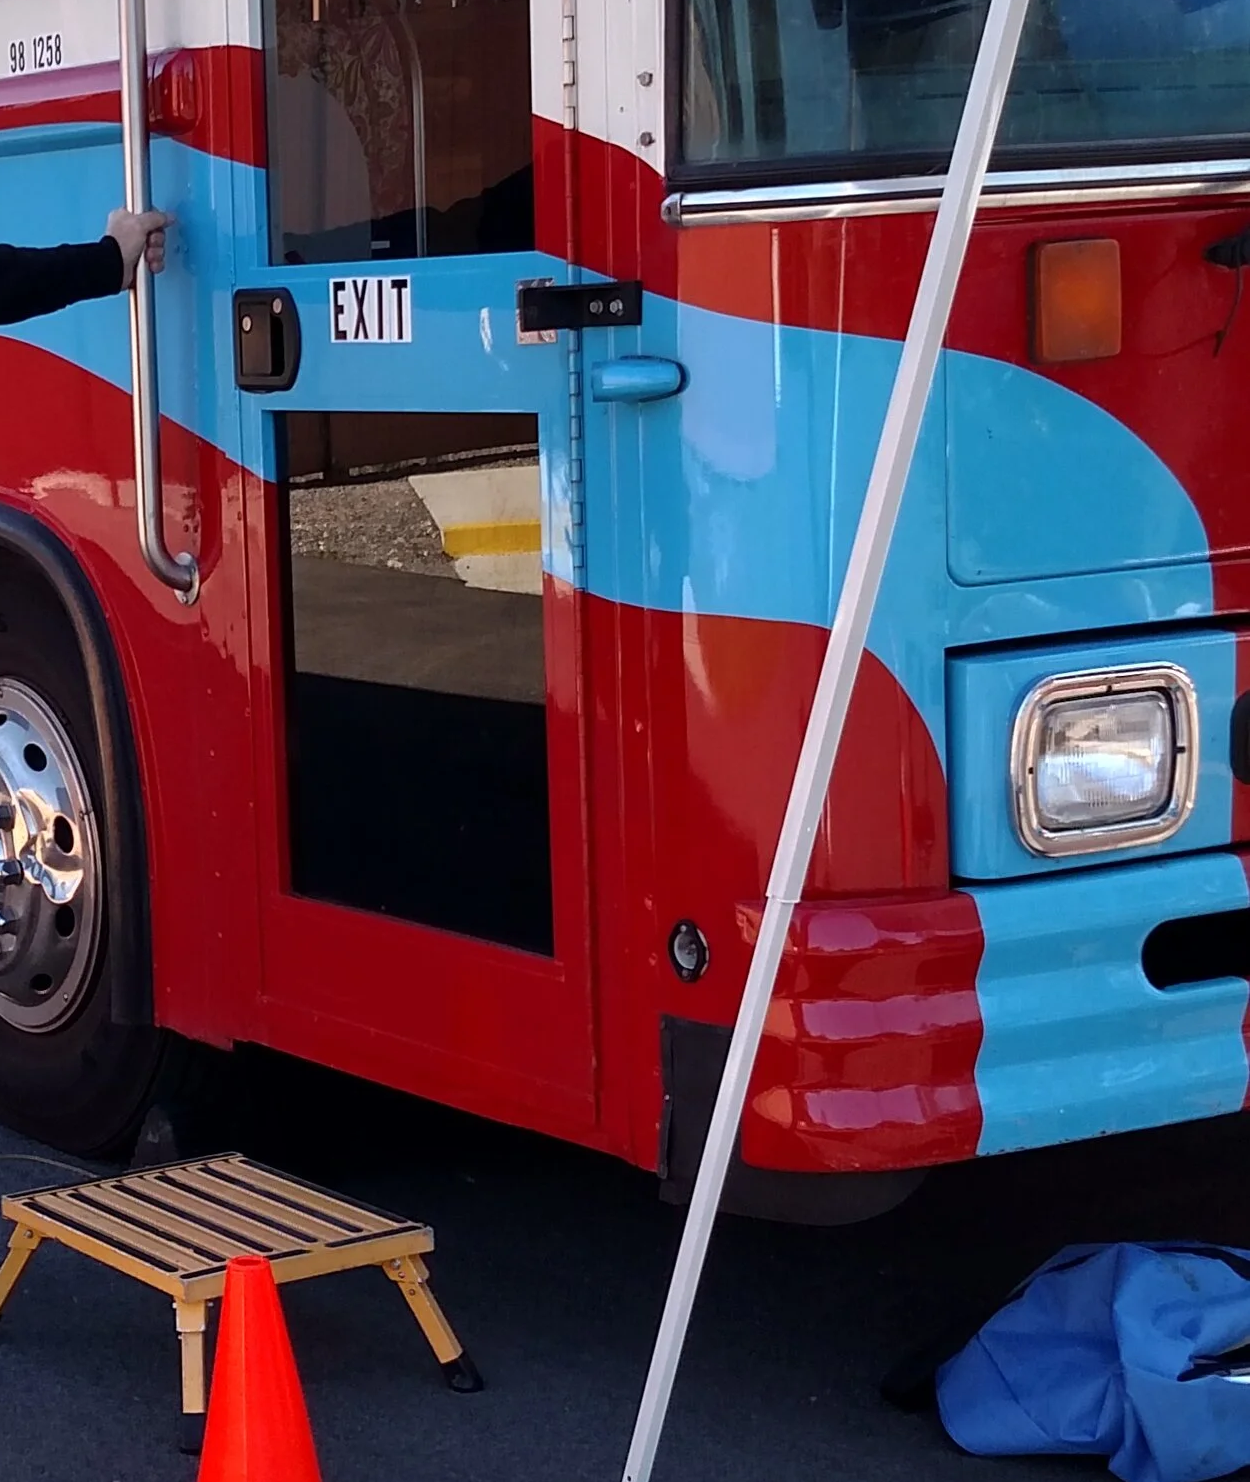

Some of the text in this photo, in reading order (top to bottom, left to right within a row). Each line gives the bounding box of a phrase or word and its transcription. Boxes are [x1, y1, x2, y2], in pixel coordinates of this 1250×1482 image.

[10, 33, 62, 73] 98 1258
[333, 279, 408, 340] EXIT
